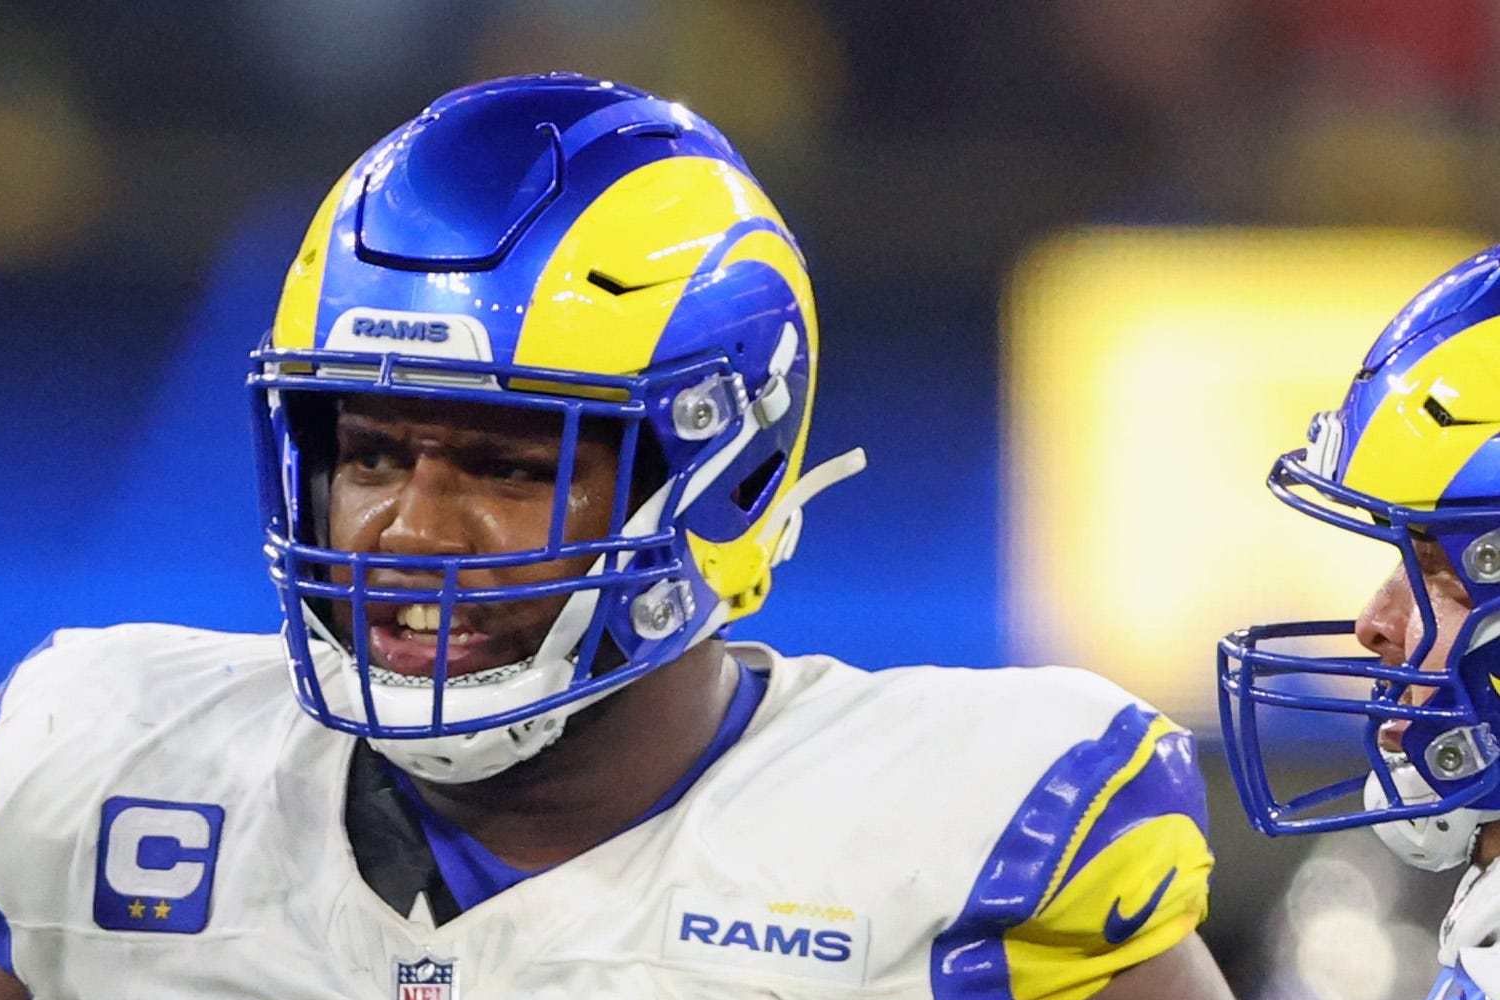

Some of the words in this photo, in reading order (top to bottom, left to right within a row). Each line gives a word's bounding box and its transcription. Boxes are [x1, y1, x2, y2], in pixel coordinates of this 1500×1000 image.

[353, 317, 449, 342] RAMS
[105, 806, 211, 899] C
[680, 912, 853, 962] RAMS
